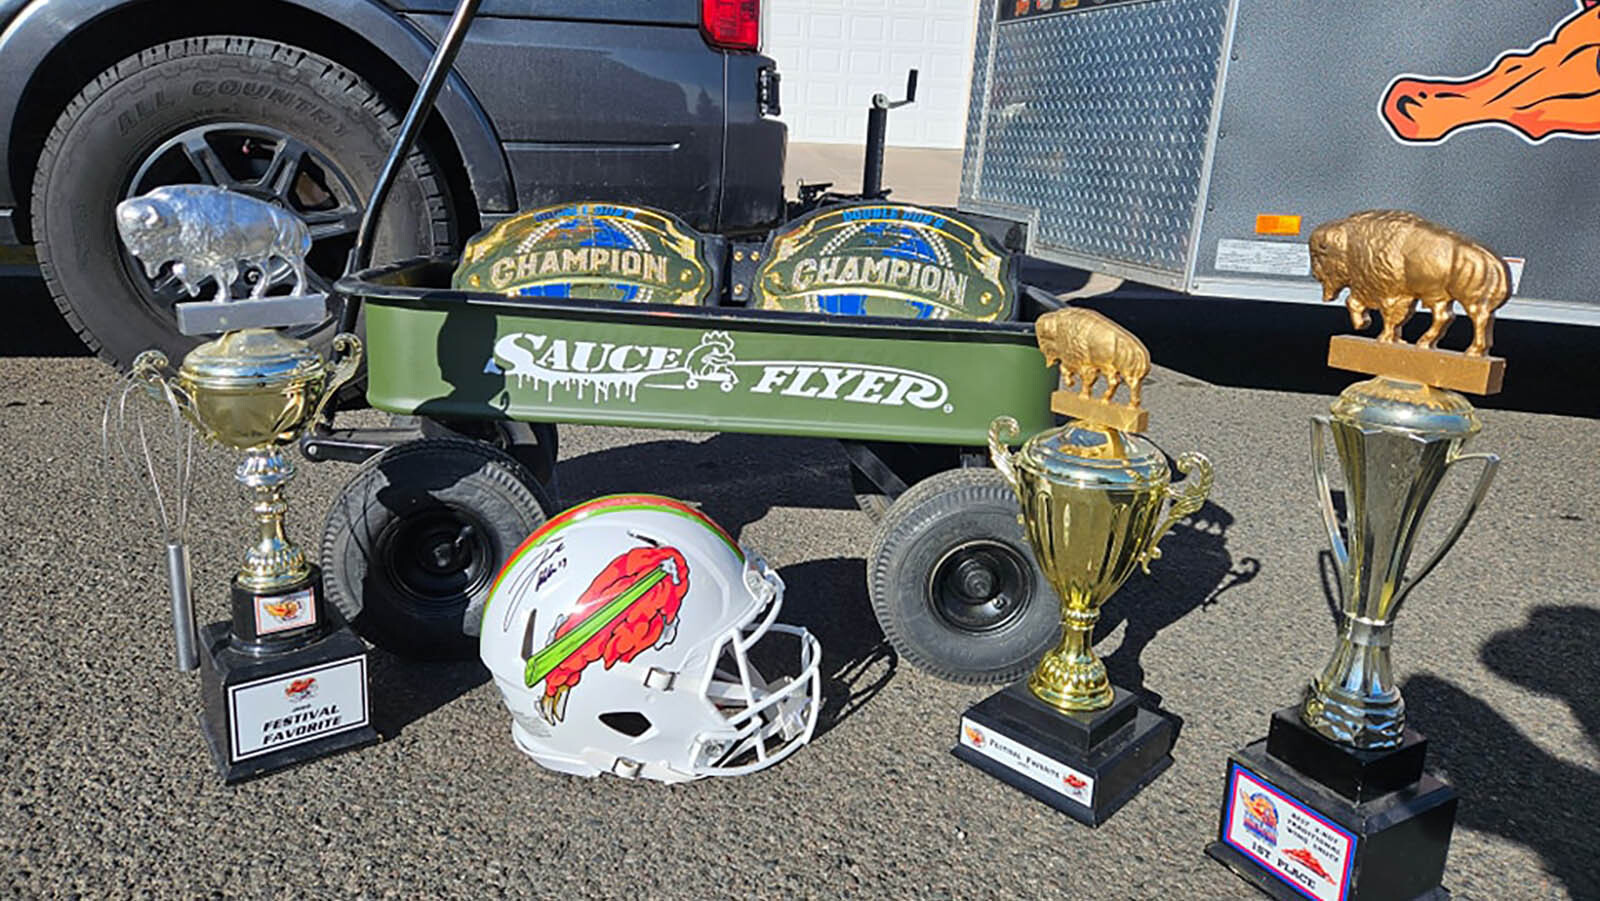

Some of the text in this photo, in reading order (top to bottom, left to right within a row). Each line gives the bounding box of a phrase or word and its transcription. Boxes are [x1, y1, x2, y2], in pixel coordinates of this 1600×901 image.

[118, 79, 348, 137] ALL COUNTRY
[490, 248, 668, 288] CHAMPION
[791, 256, 969, 308] CHAMPION
[494, 332, 949, 409] SAUCE FLYER
[263, 705, 340, 732] FESTIVAL
[263, 716, 342, 745] FAVORITE
[1287, 818, 1341, 855] TRADITIONAL
[1251, 841, 1317, 890] 1ST PLACE
